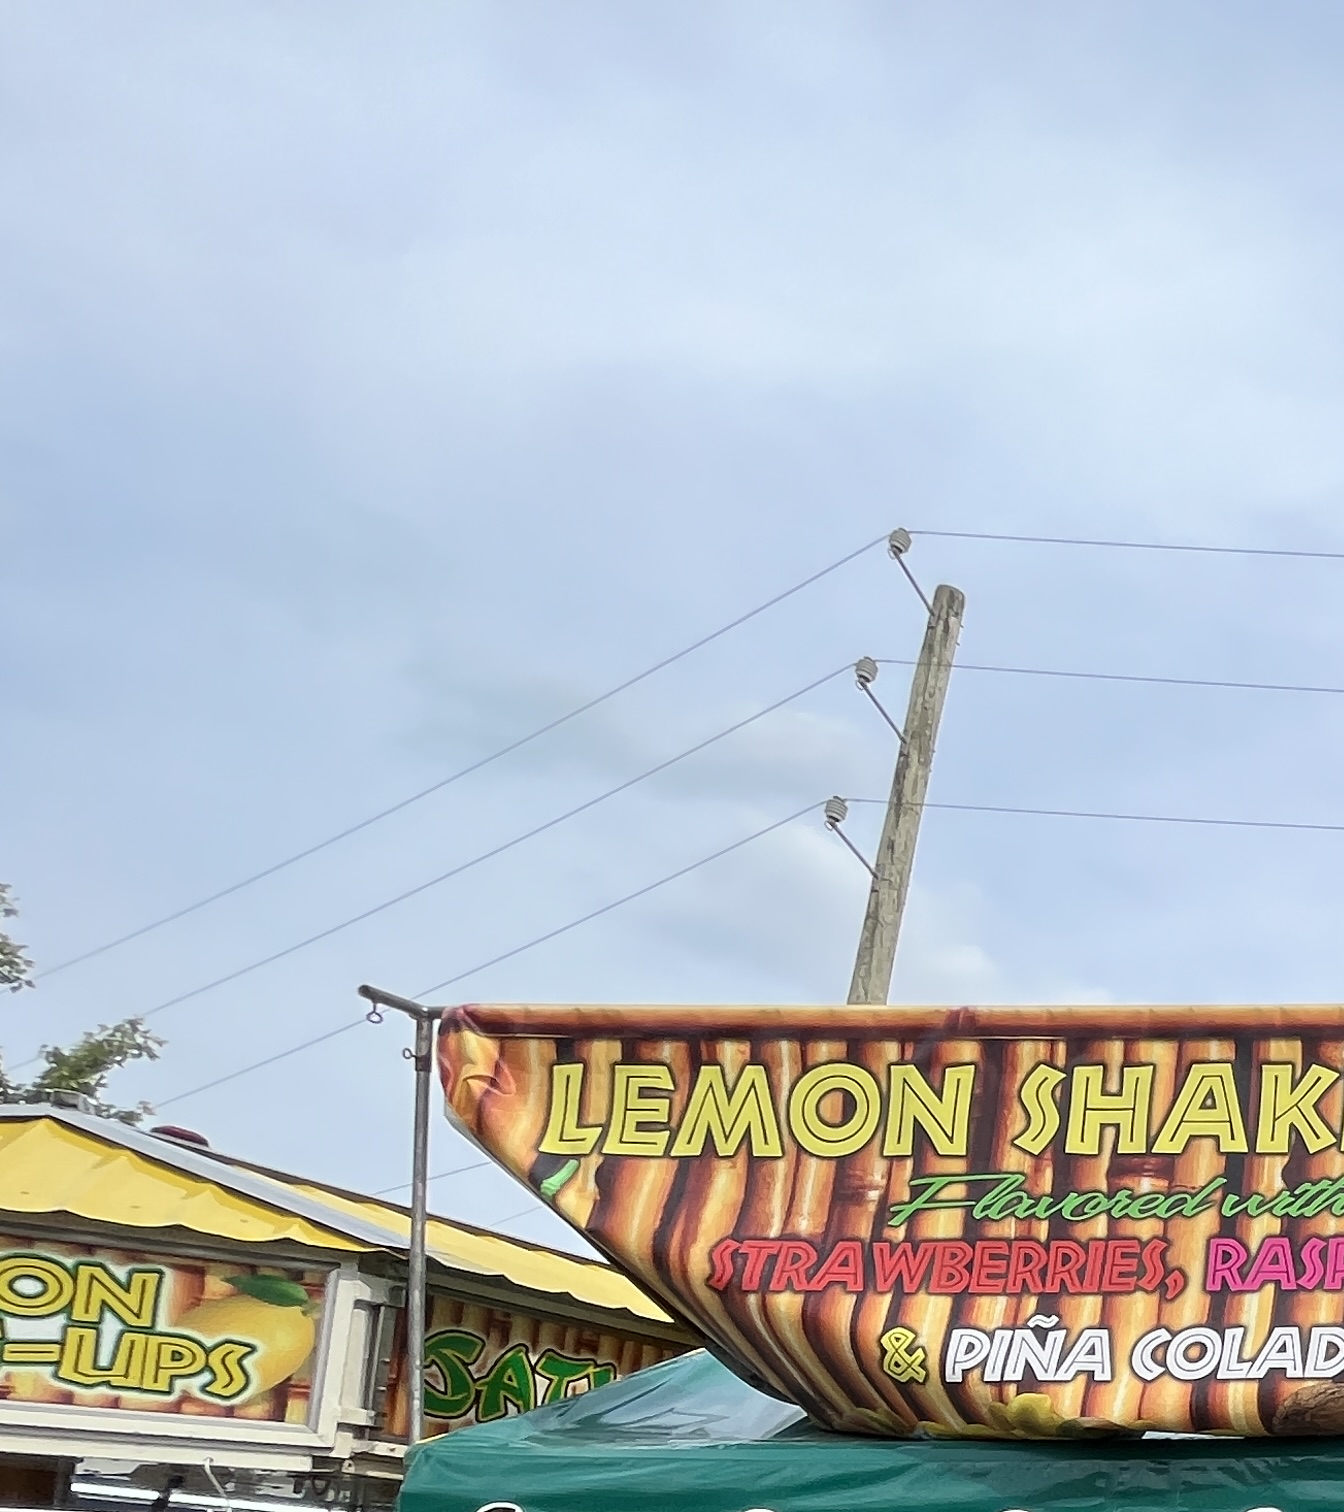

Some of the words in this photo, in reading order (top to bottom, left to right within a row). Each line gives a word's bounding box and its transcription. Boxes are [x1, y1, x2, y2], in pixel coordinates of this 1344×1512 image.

[540, 1063, 976, 1158] LEMON
[888, 1173, 1230, 1227] Flavored
[706, 1237, 1187, 1299] STRAWBERRIES,
[880, 1327, 927, 1384] &
[945, 1315, 1111, 1383] PIÑA
